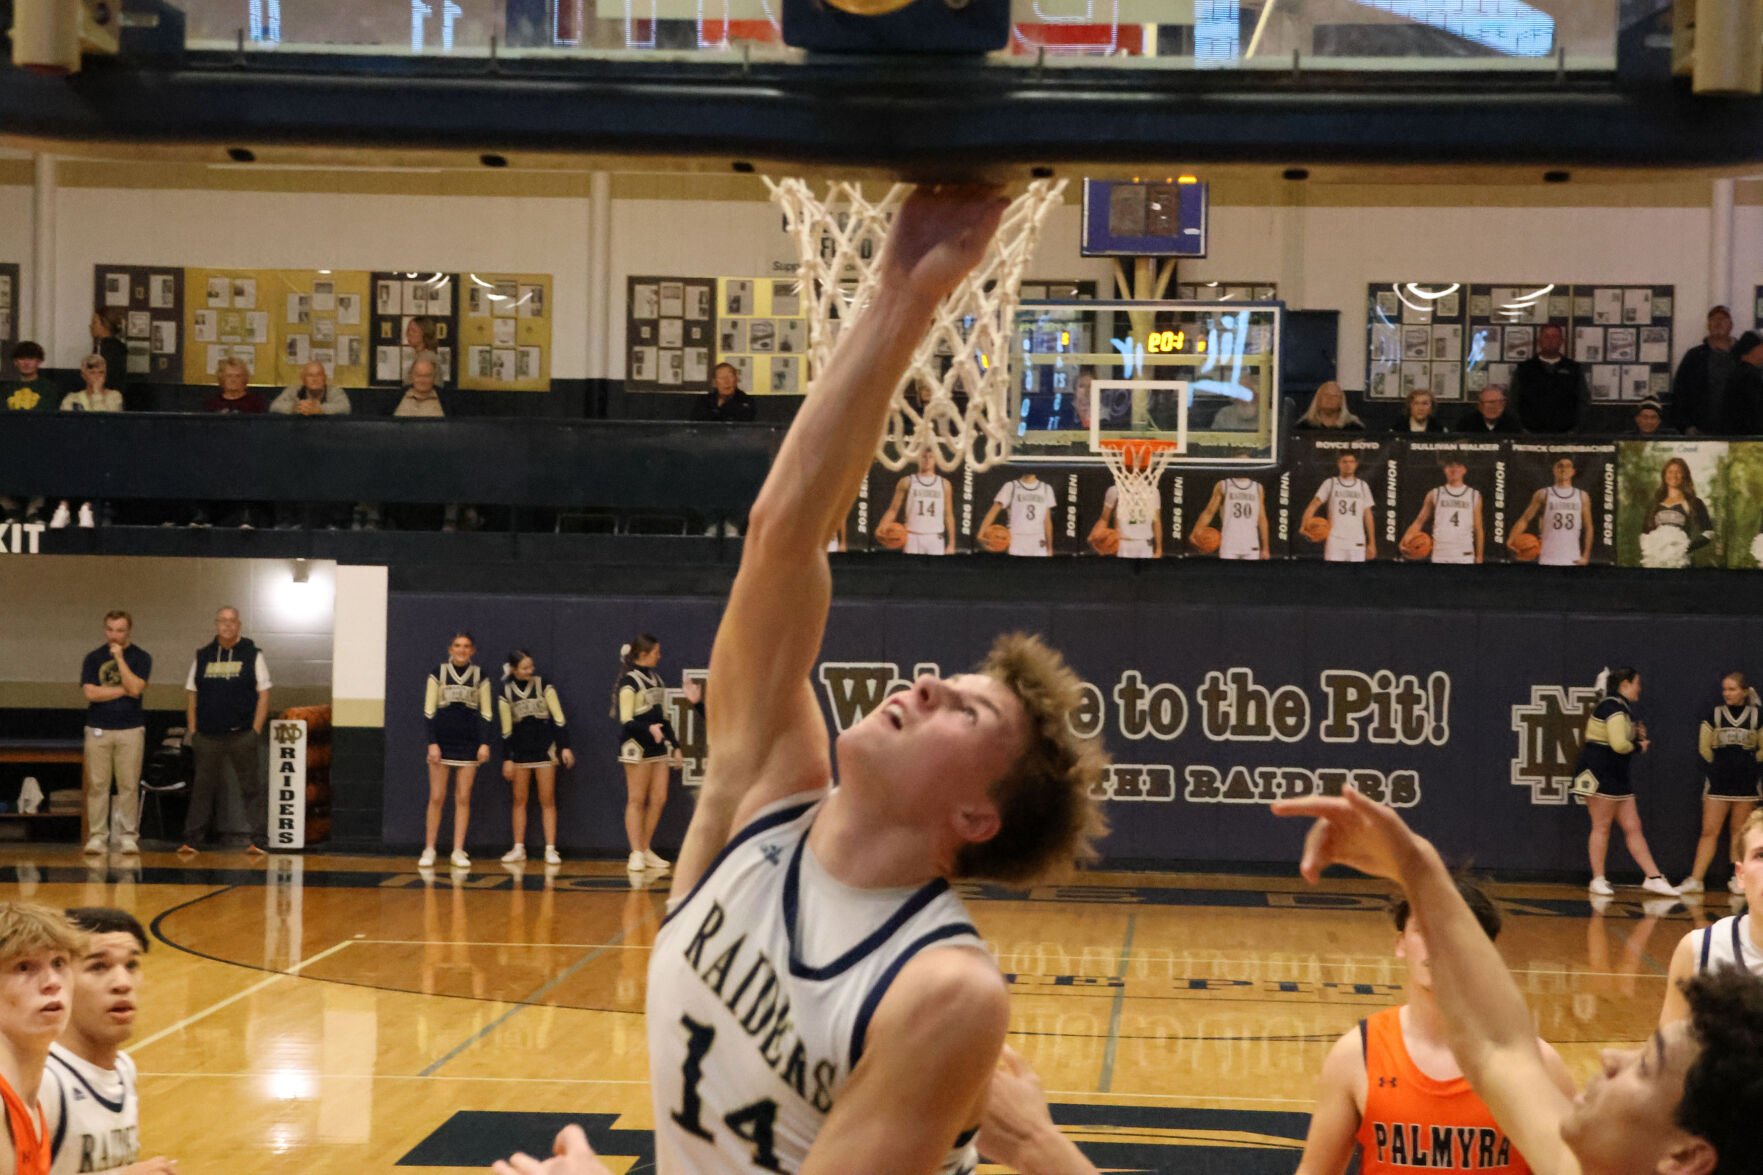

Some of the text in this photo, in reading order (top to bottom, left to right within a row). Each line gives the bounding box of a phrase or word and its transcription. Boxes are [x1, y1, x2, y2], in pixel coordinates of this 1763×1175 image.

[1315, 441, 1380, 450] ROYCE BOYD
[1410, 442, 1500, 451] SULLIVAN WALKER
[917, 500, 936, 517] 14
[961, 504, 972, 535] 2026
[1025, 504, 1036, 521] 3
[1066, 474, 1078, 537] 2026 SENI
[1233, 502, 1252, 519] 30
[1278, 471, 1290, 541] 2026 SENI
[1338, 500, 1357, 516] 34
[1386, 459, 1397, 542] 2026 SENIOR
[1449, 511, 1460, 527] 4
[1494, 461, 1505, 544] 2026 SENIOR
[1553, 512, 1575, 530] 33
[1603, 463, 1614, 546] 2026 SENIOR
[1172, 508, 1182, 540] 2026
[1113, 670, 1188, 740] to
[1197, 667, 1310, 742] the
[1320, 669, 1450, 746] Pit!
[278, 747, 296, 844] RAIDERS
[1184, 765, 1421, 808] RAIDERS
[684, 900, 838, 1115] RAIDERS
[668, 1012, 793, 1175] 14
[1372, 1121, 1512, 1170] PALMYRA
